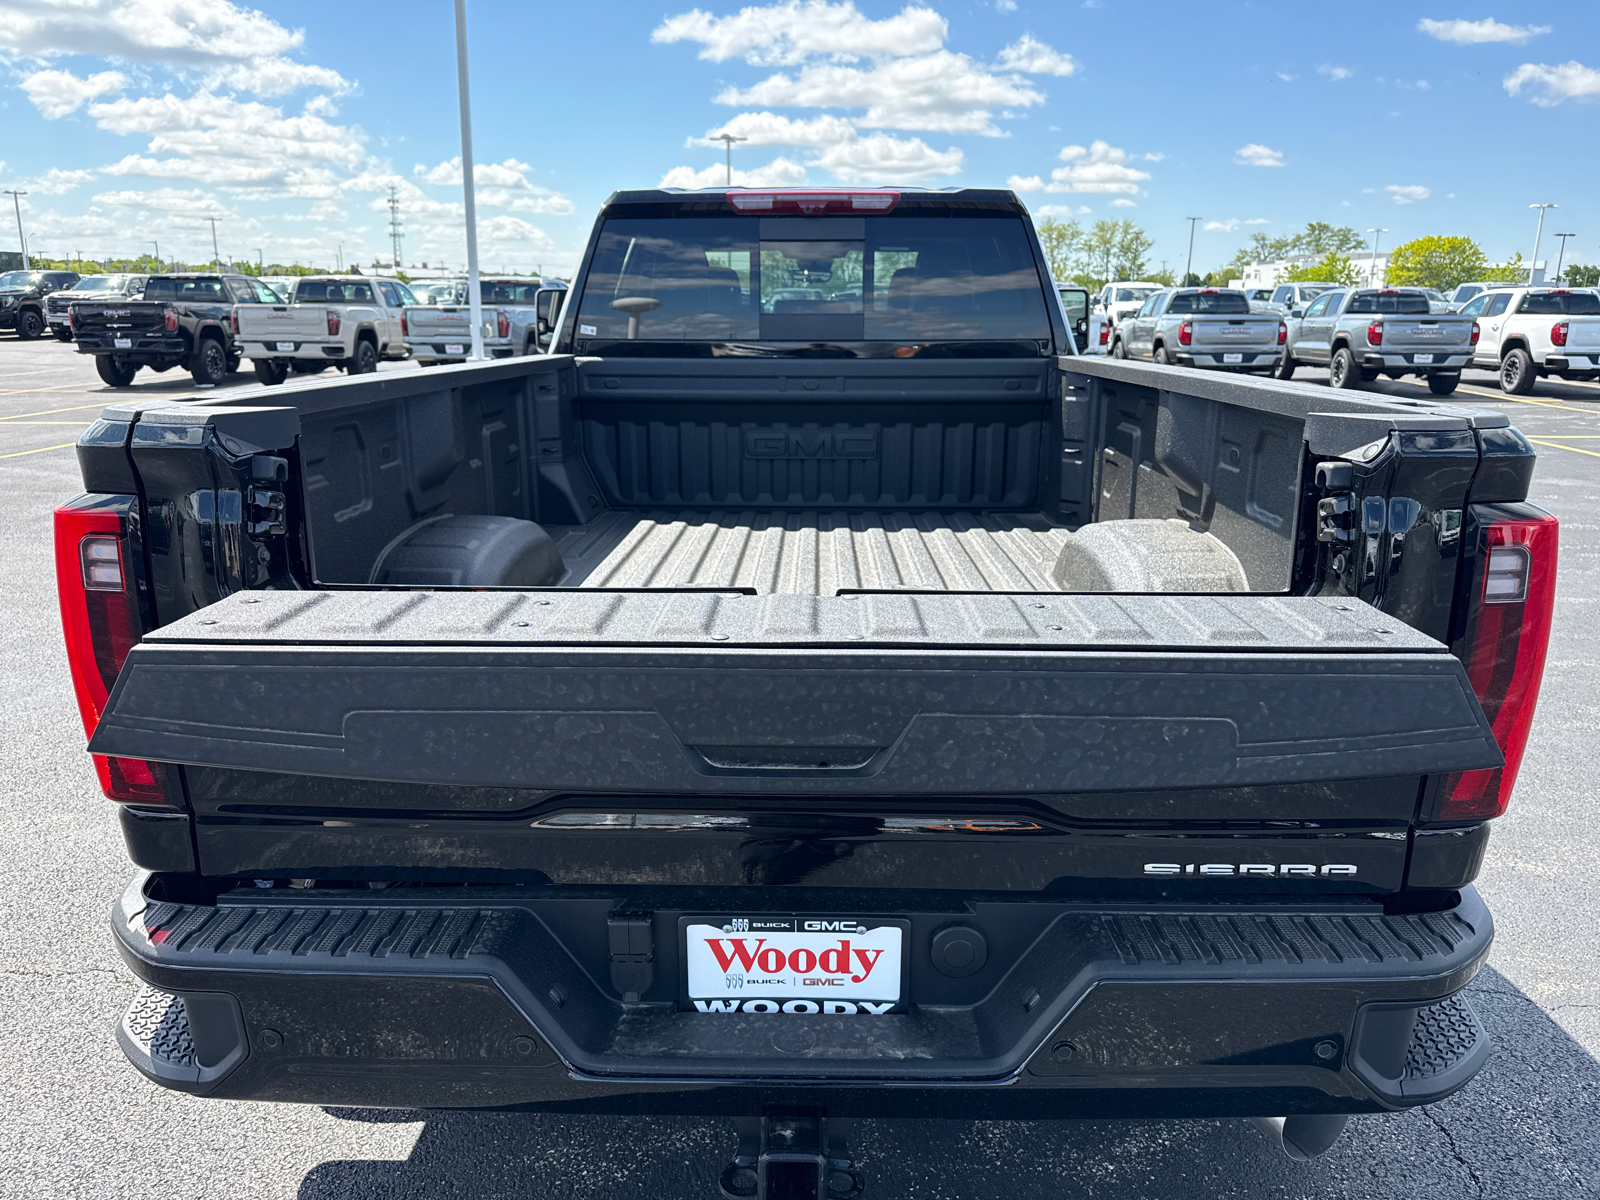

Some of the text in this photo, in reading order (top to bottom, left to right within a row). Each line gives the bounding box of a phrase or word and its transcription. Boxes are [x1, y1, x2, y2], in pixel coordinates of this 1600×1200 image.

[746, 432, 875, 458] GMC
[1143, 863, 1358, 877] SIERRA
[804, 921, 857, 931] GMC
[703, 938, 885, 983] Woody
[802, 977, 845, 986] GMC
[693, 999, 896, 1015] WOODY
